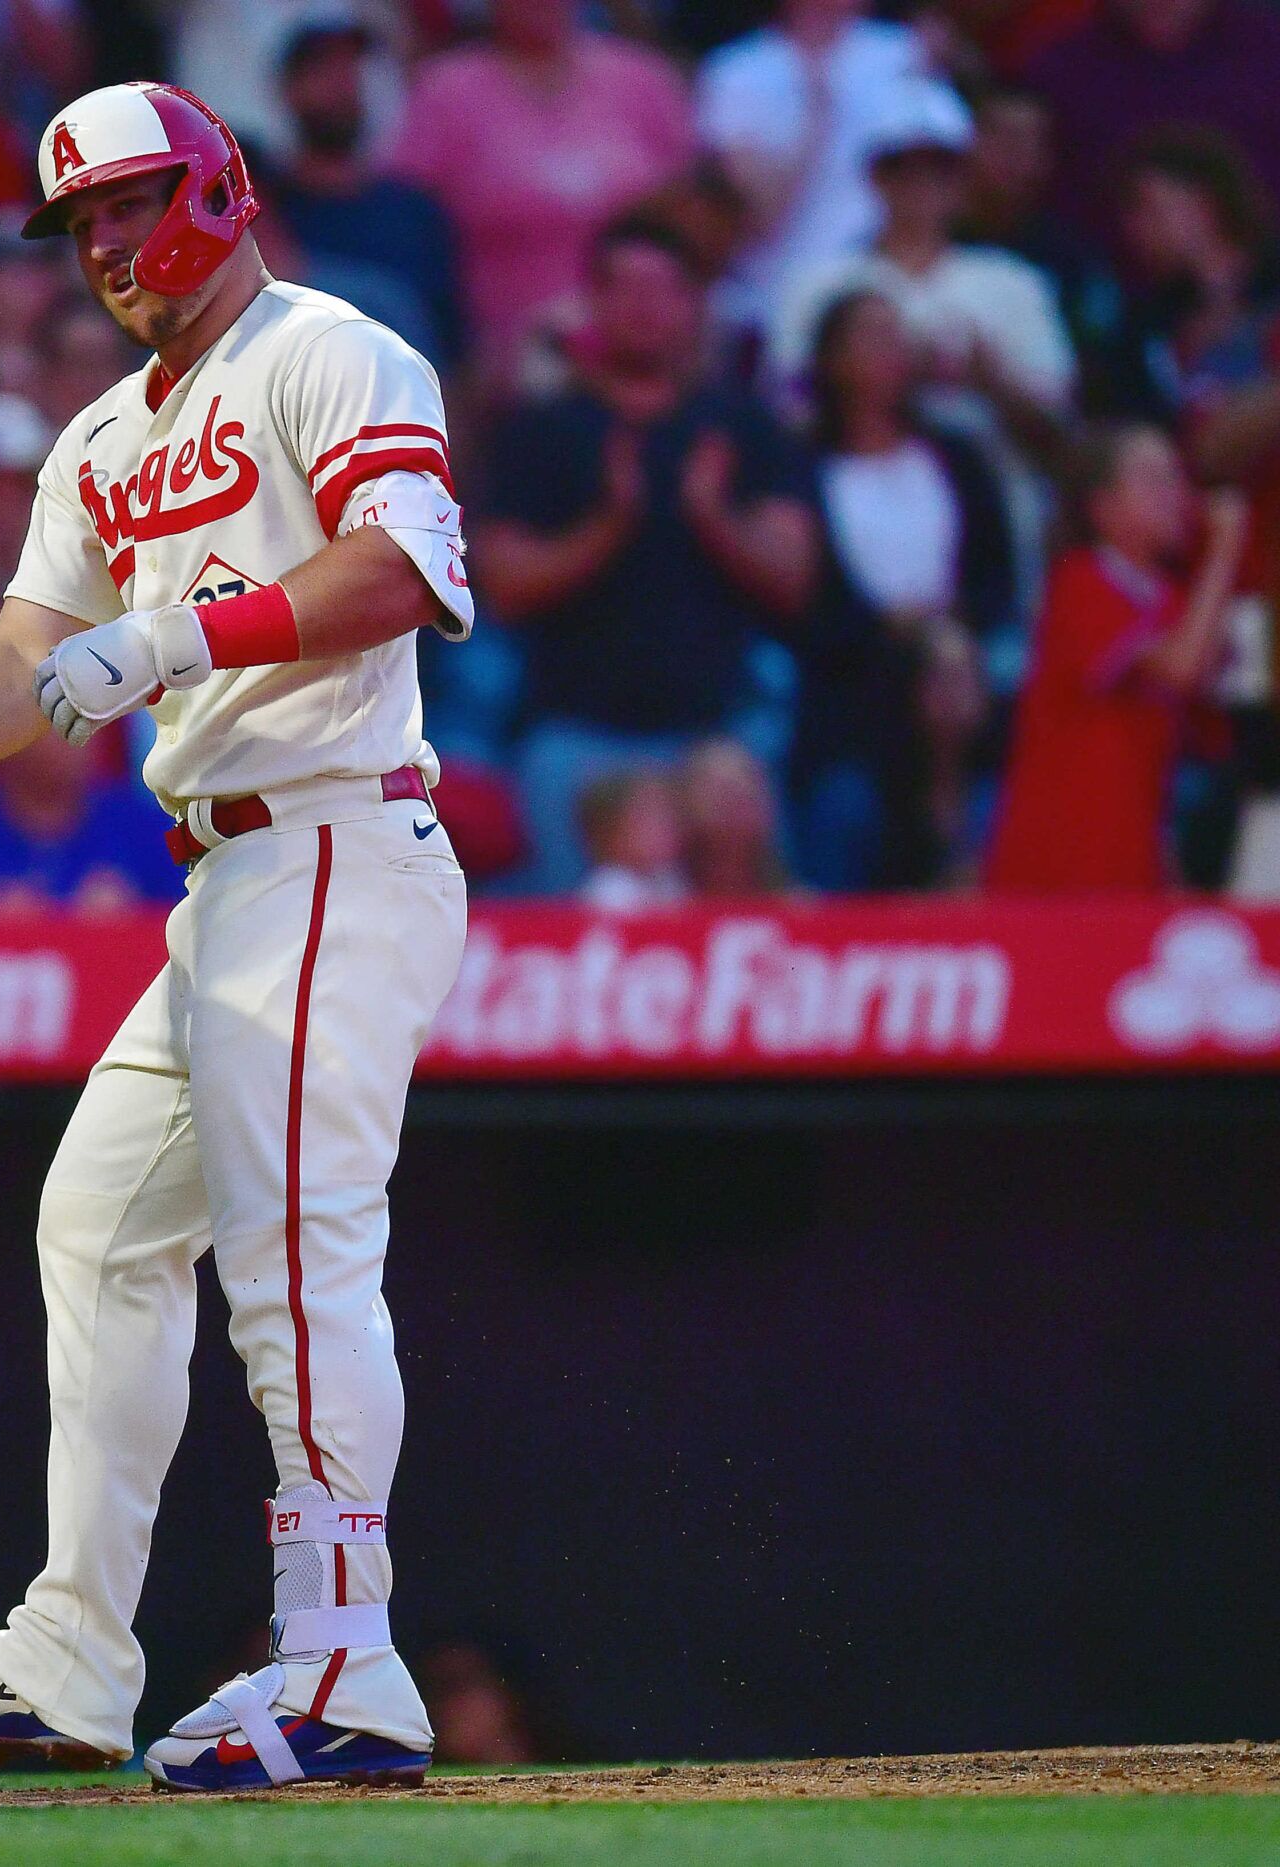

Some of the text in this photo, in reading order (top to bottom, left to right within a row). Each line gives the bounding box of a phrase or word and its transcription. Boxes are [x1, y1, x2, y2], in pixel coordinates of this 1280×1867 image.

[52, 120, 87, 182] A
[77, 394, 261, 550] Angels
[423, 920, 1011, 1058] tateFarm
[276, 1511, 301, 1533] 27
